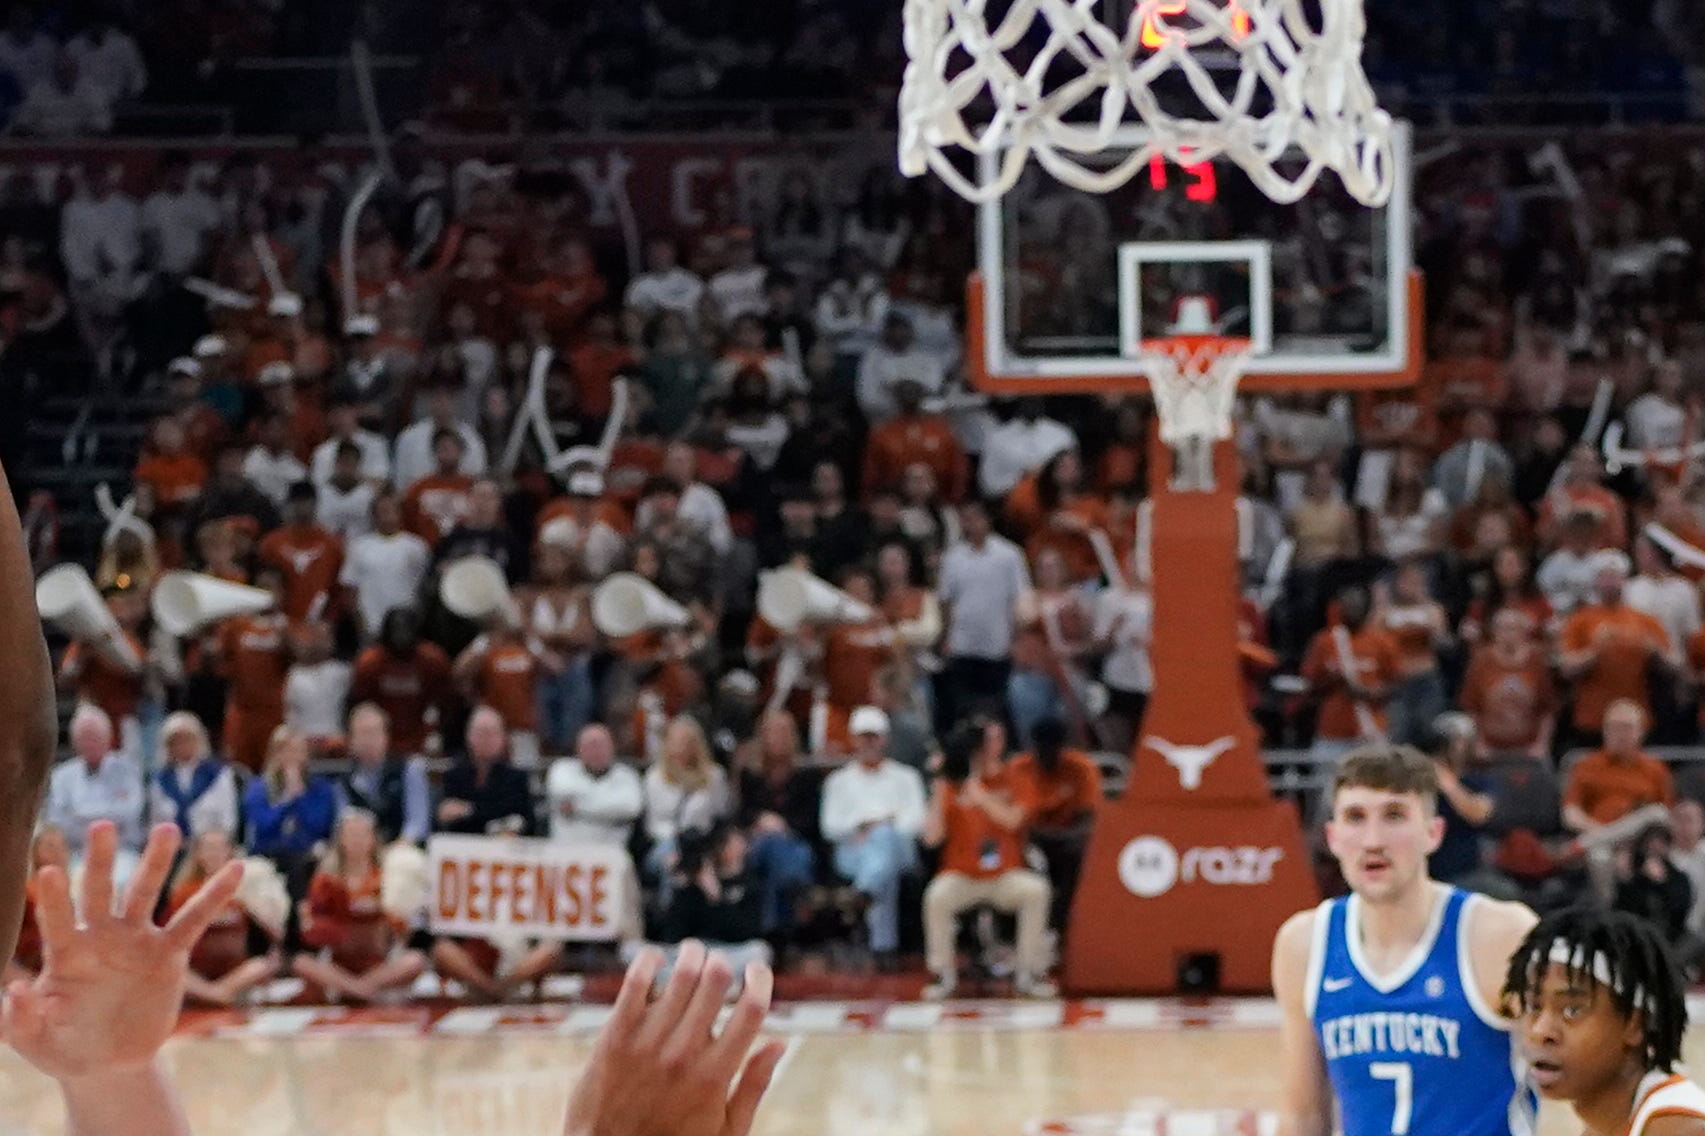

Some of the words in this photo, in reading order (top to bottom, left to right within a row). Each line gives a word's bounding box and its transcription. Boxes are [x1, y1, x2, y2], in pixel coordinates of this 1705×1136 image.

[439, 859, 610, 926] DEFENSE
[1182, 846, 1285, 885] razr
[1322, 1012, 1460, 1060] KENTUCKY
[1369, 1062, 1412, 1136] 7
